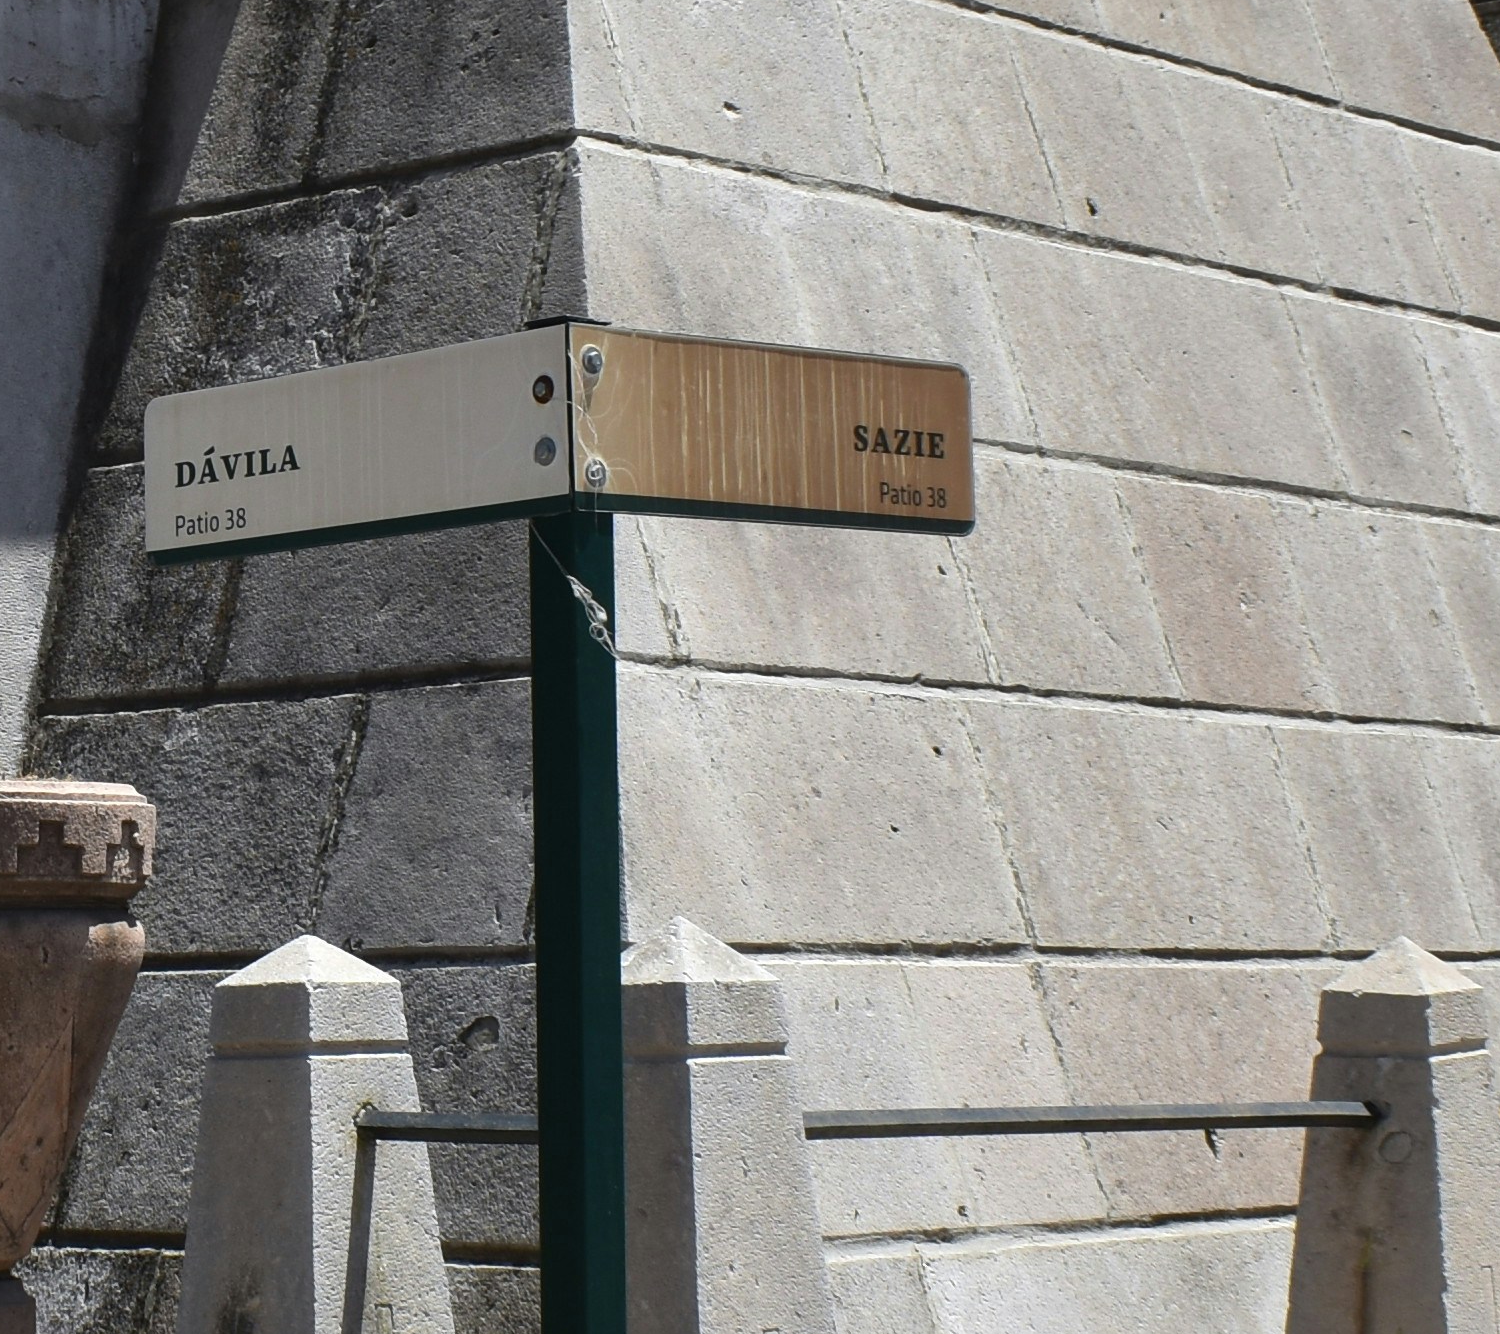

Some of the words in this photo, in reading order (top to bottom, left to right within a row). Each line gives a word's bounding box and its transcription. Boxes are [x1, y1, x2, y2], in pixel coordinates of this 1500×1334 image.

[852, 424, 946, 460] SAZIE
[174, 446, 302, 490] DÁVILA
[879, 481, 923, 508] Patio
[926, 487, 948, 510] 38
[174, 510, 220, 538] Patio
[224, 507, 248, 532] 38
